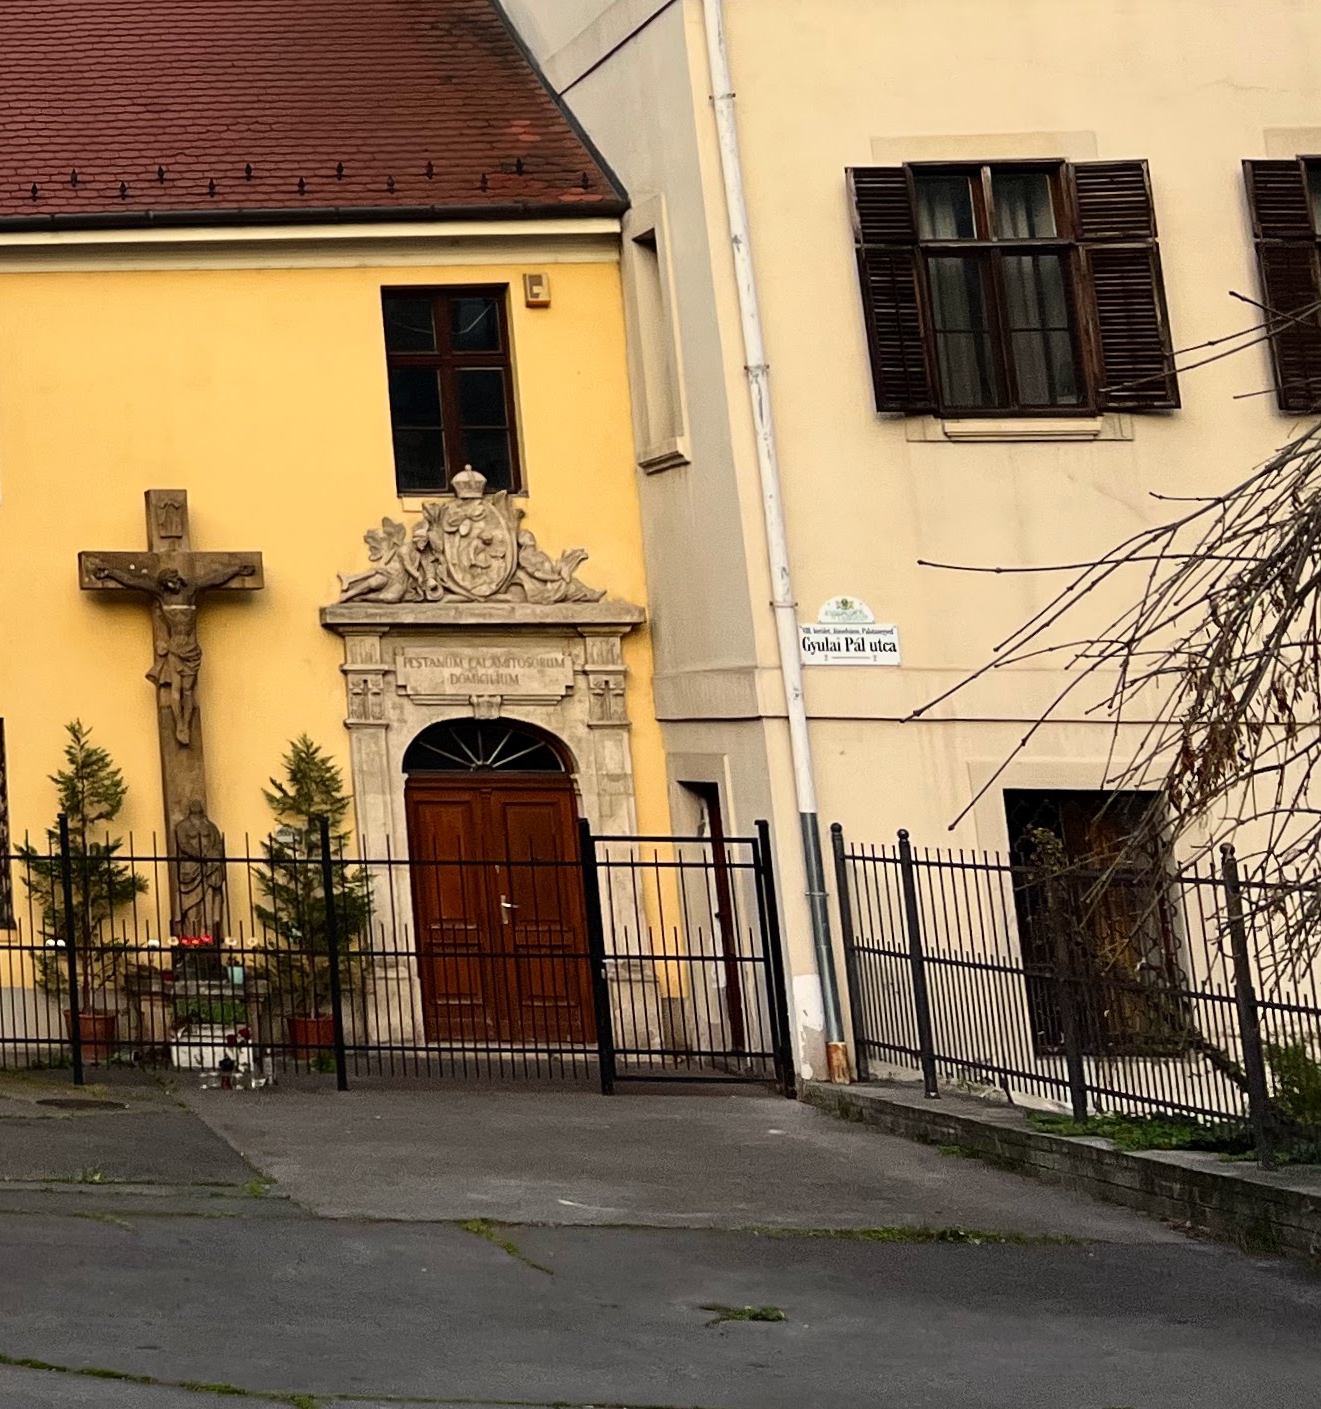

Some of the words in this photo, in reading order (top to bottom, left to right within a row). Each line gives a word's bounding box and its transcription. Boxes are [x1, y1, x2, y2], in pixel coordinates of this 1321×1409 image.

[801, 636, 841, 655] Gyulai
[845, 636, 866, 652] Pál
[869, 638, 897, 653] utca
